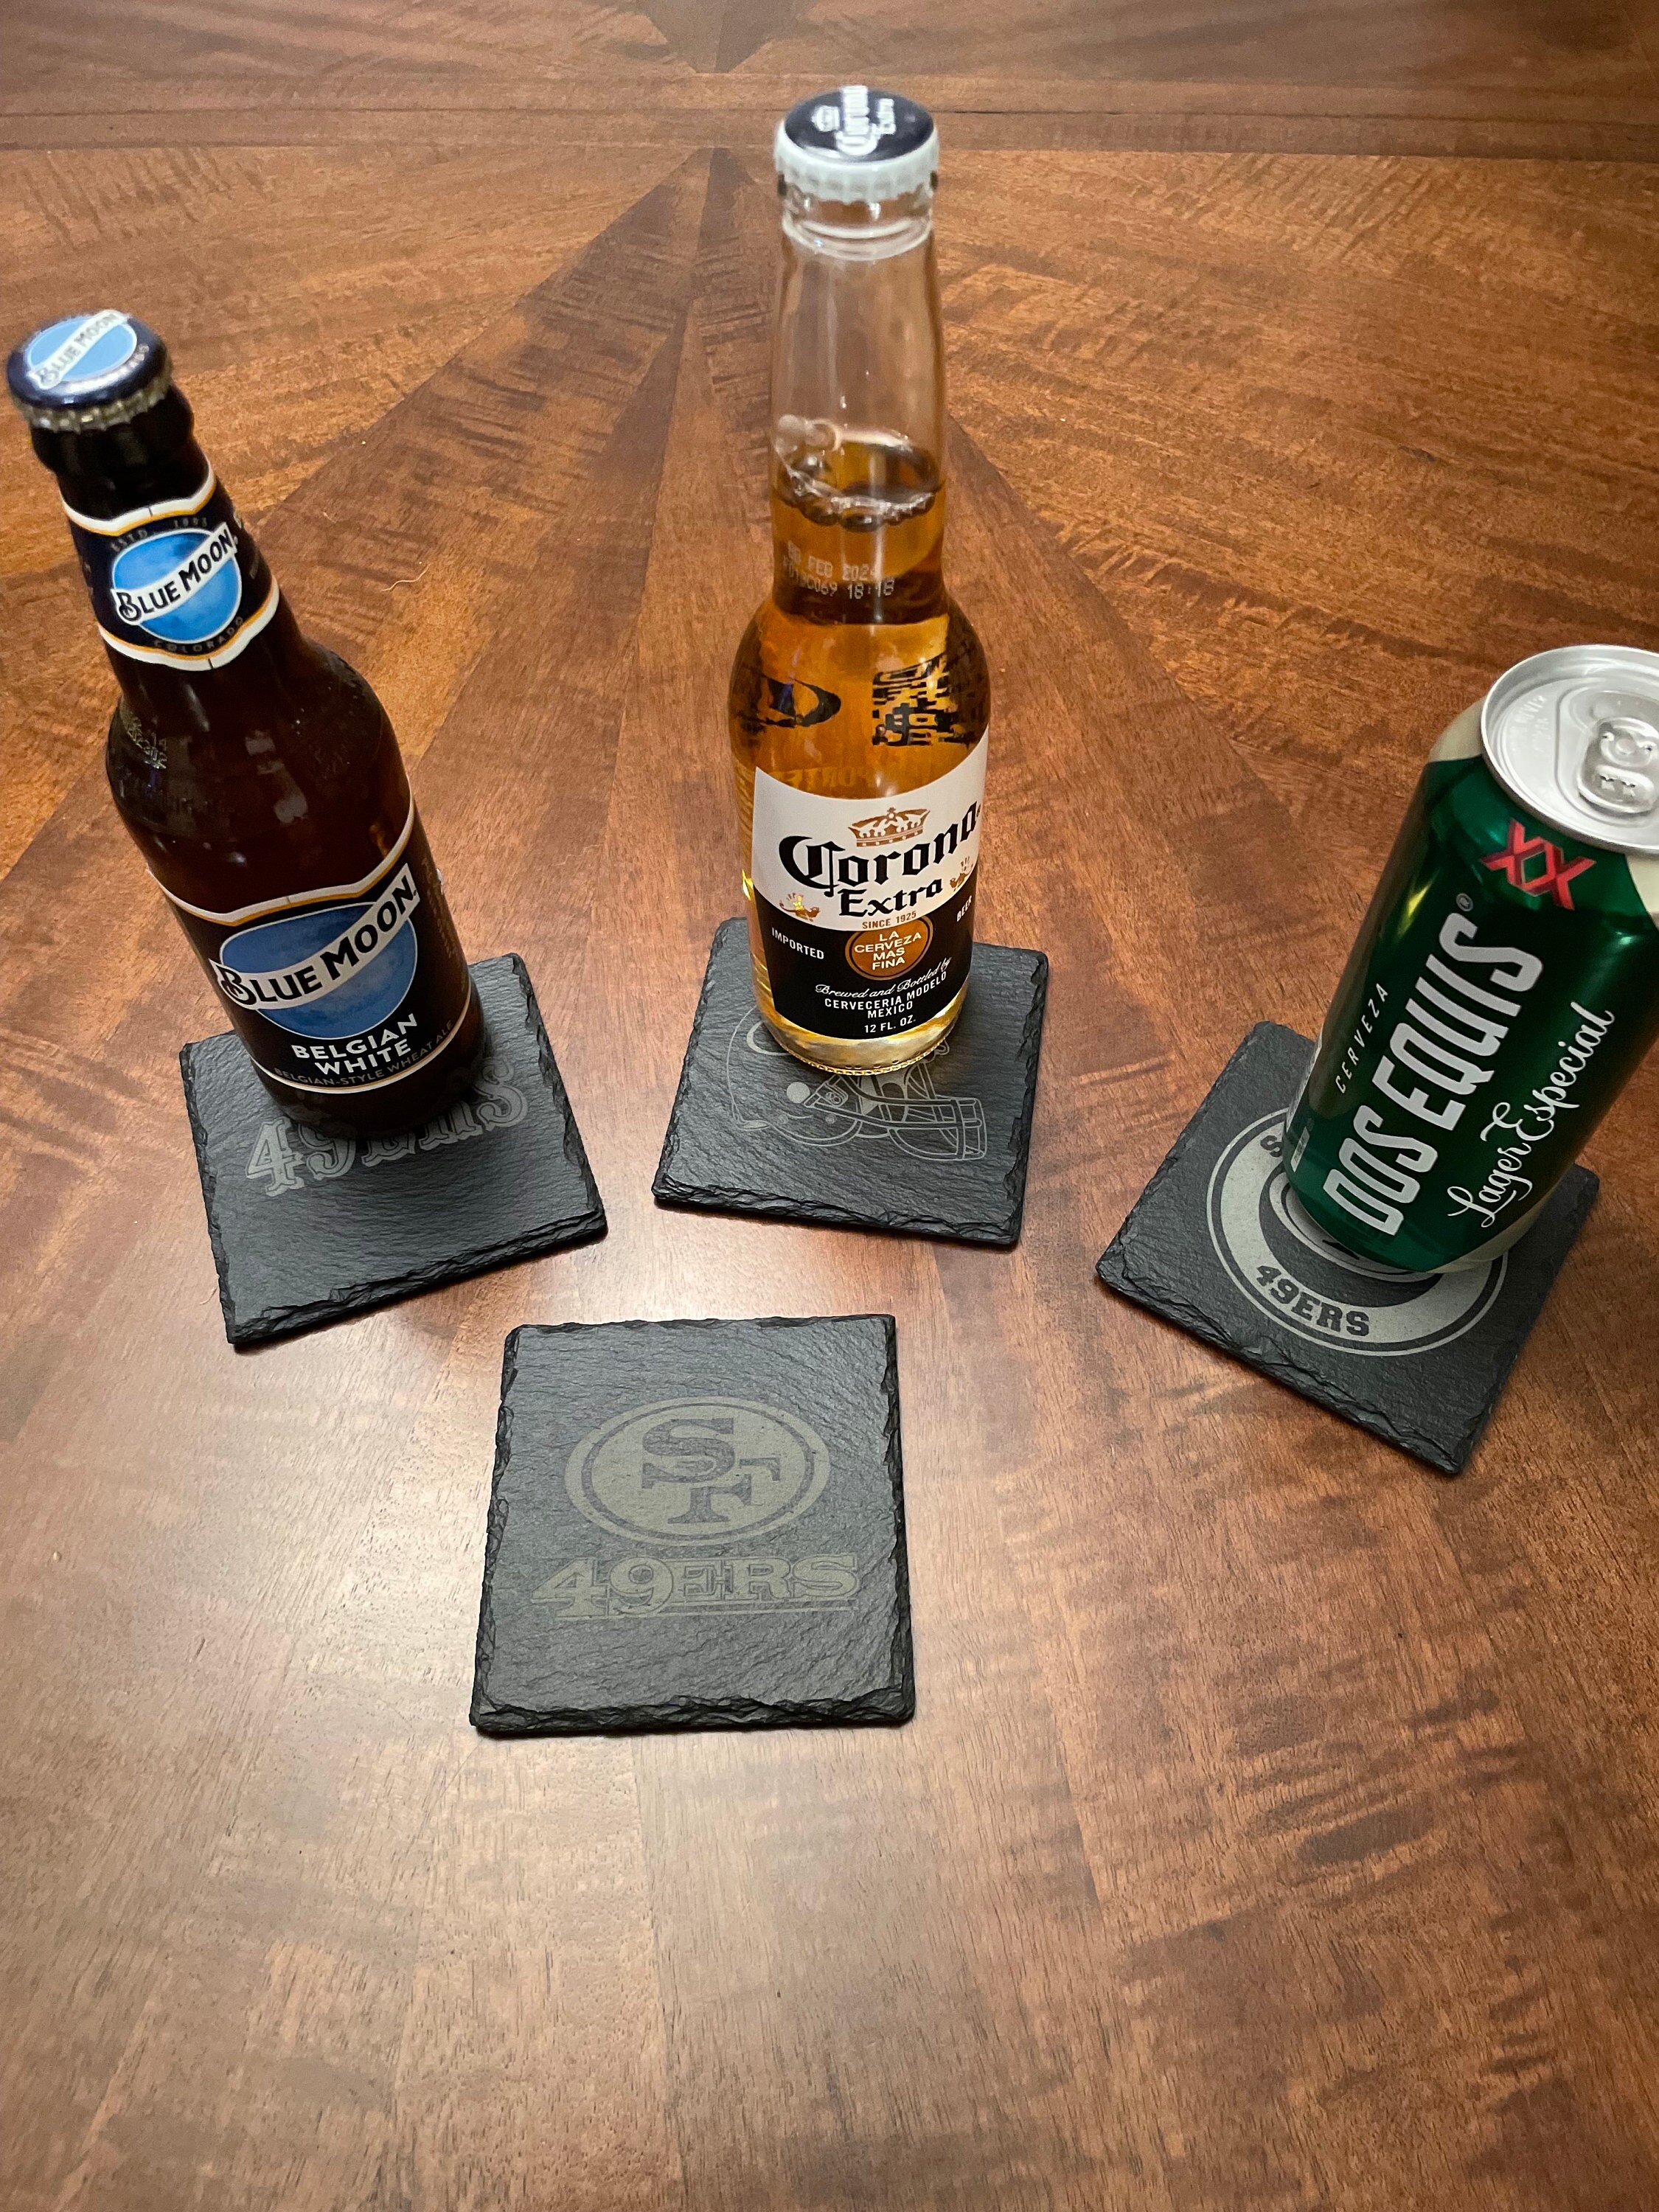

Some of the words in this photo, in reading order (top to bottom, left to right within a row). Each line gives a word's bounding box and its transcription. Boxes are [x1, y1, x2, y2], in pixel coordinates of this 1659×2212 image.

[116, 580, 181, 622] BLUE
[178, 529, 234, 593] MOON
[779, 801, 978, 898] Corona
[1479, 818, 1596, 911] XX
[838, 878, 943, 917] Extra
[861, 919, 891, 930] SINCE
[895, 911, 917, 923] 1925
[956, 895, 973, 922] BEER
[215, 964, 323, 1006] BLUE
[319, 875, 414, 981] MOON
[771, 926, 825, 959] IMPORTED
[853, 931, 922, 953] CERVEZA
[872, 947, 905, 961] MAS
[878, 931, 900, 942] LA
[815, 984, 869, 998] Brewed
[869, 984, 897, 998] and
[897, 967, 940, 991] Bottled
[939, 956, 953, 975] by
[872, 958, 906, 971] FINA
[824, 995, 902, 1011] CERVECERIA
[906, 970, 947, 1002] MODELO
[867, 1001, 914, 1019] MEXICO
[291, 1013, 417, 1060] BELGIAN
[864, 1024, 877, 1034] 12
[880, 1020, 897, 1032] FL.
[1335, 983, 1389, 1095] CERVEZA
[1371, 911, 1544, 1131] EQUIS
[274, 1067, 384, 1086] BELGIAN-STYLE
[387, 1042, 432, 1074] WHEAT
[436, 1020, 453, 1045] ALE
[315, 1038, 411, 1075] WHITE
[1480, 1001, 1615, 1142] Especial
[1322, 1105, 1439, 1237] DOS
[1447, 1142, 1533, 1228] Lager
[1256, 1265, 1371, 1338] 49ERS
[641, 1416, 781, 1525] SF
[529, 1551, 862, 1621] 49ERS
